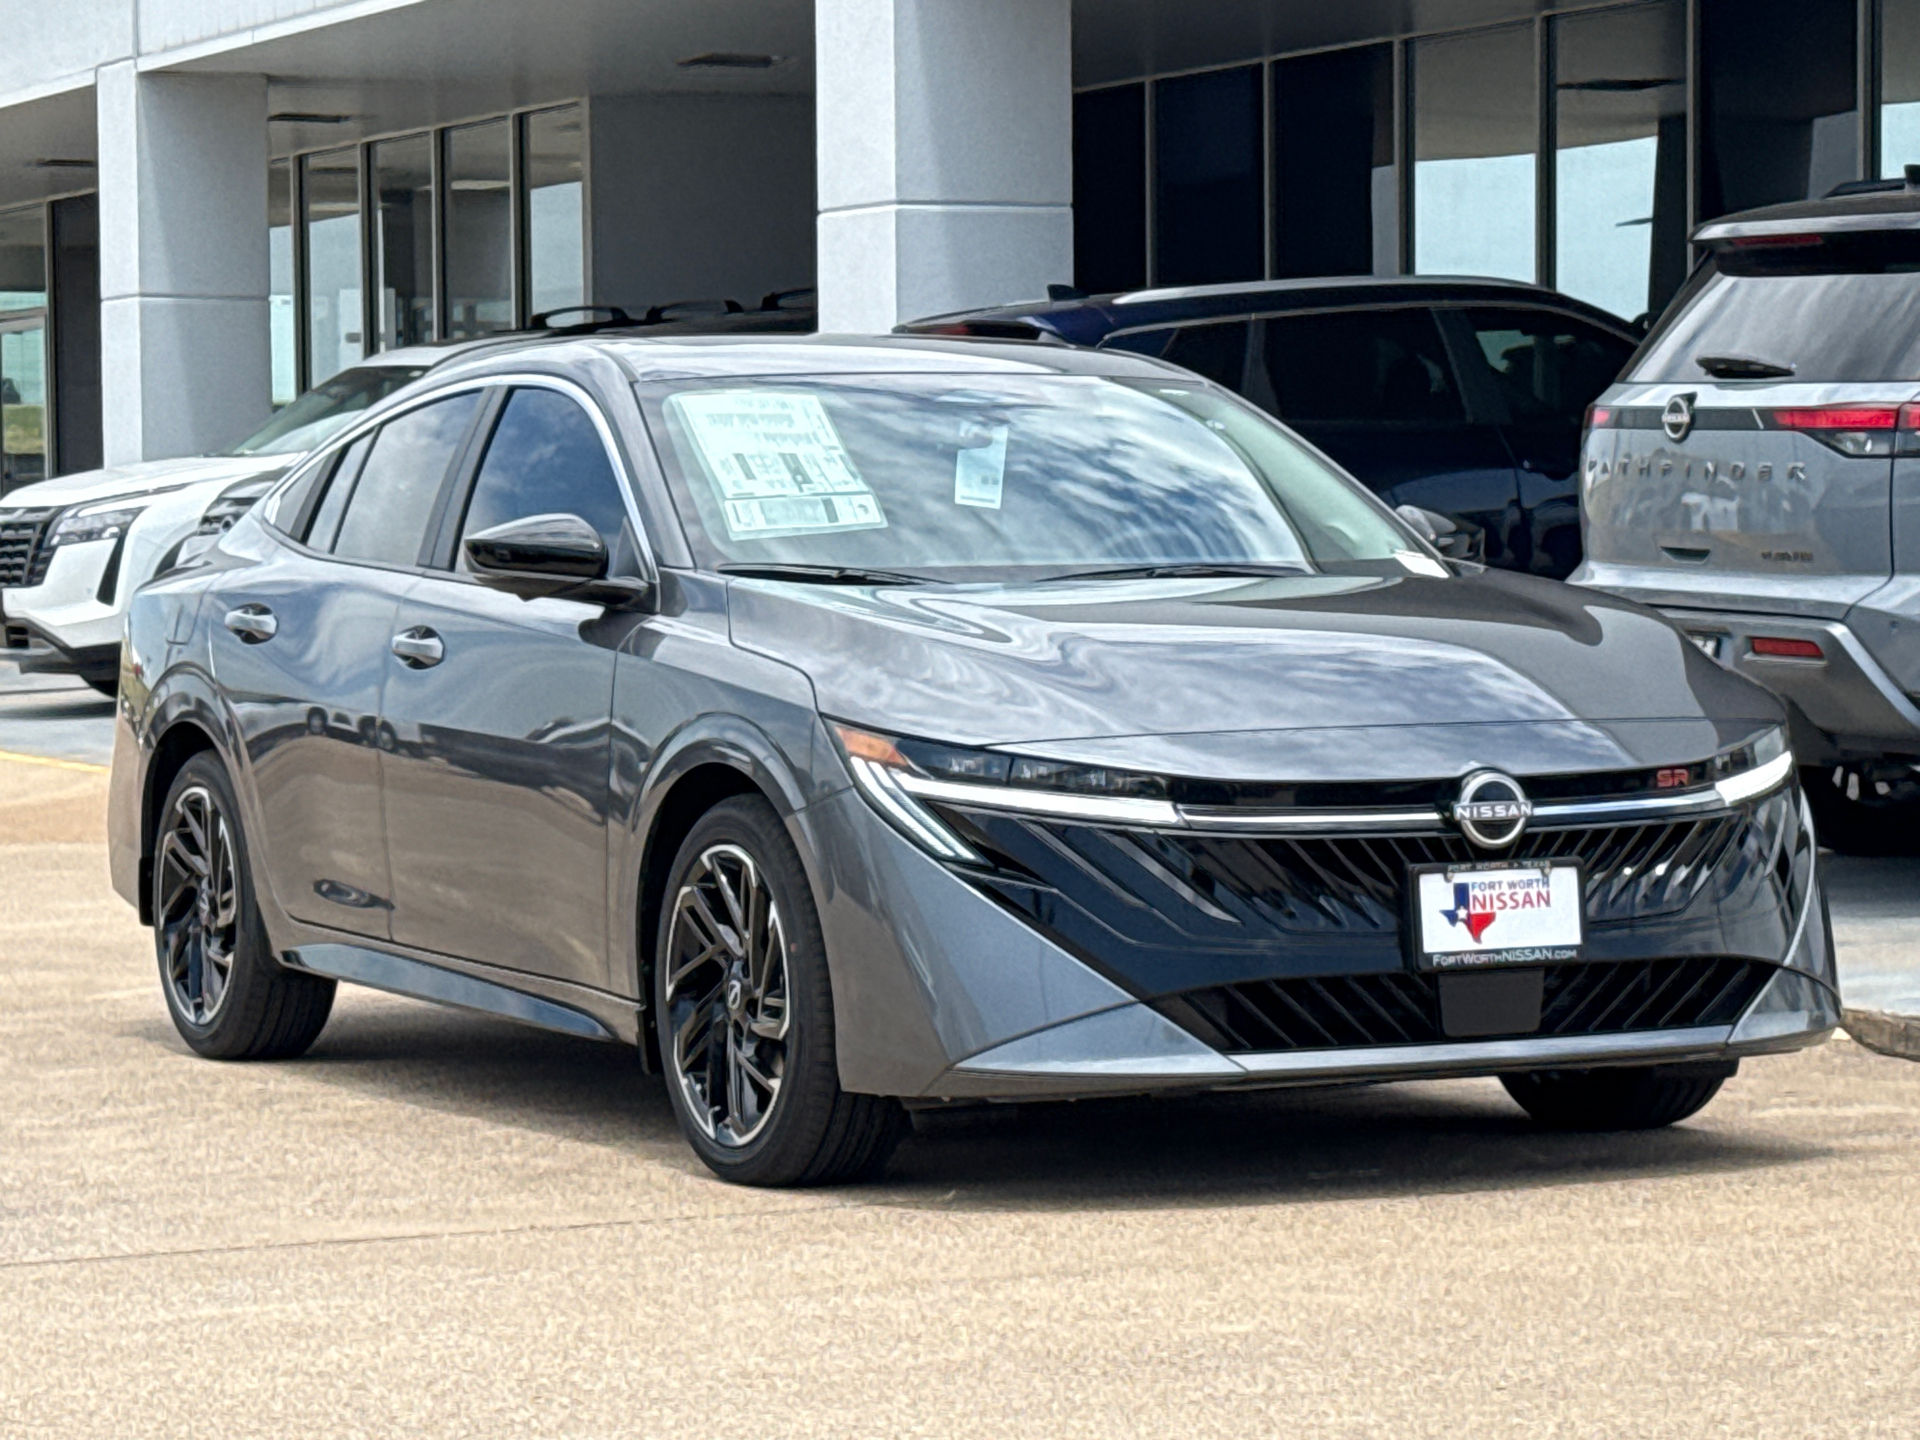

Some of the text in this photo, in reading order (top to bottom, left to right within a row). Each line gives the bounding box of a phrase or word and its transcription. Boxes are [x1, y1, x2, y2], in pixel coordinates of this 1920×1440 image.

[1587, 459, 1806, 482] PATHFINDER
[1656, 768, 1690, 788] SR
[1454, 802, 1532, 819] NISSAN
[1471, 878, 1550, 892] FORT WORTH
[1472, 890, 1551, 911] NISSAN
